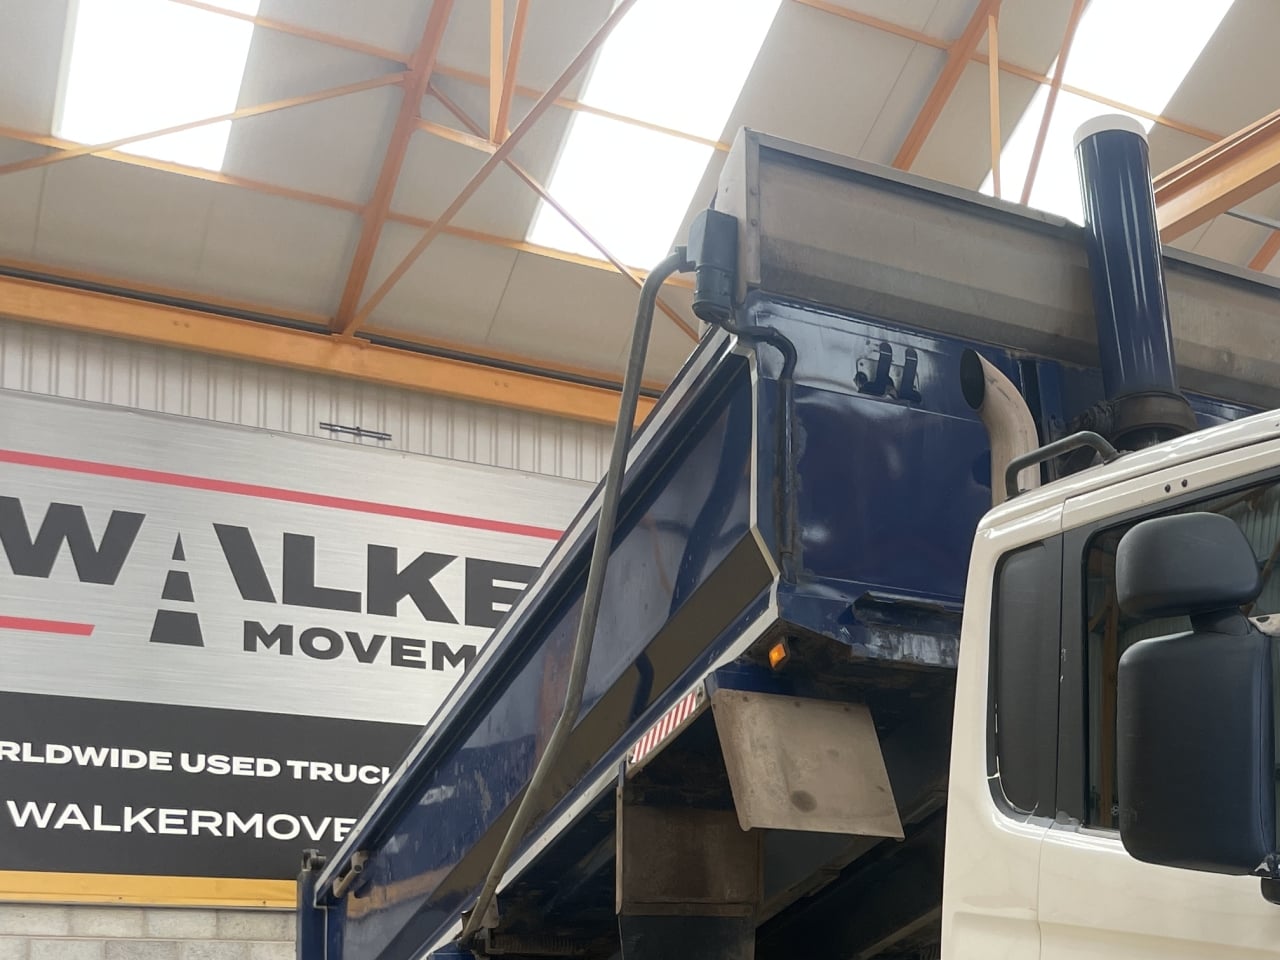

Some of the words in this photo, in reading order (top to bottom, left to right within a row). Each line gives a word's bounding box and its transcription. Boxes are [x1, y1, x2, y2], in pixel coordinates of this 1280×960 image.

[243, 620, 477, 673] MOVEM
[0, 740, 173, 773] RLDWIDE
[180, 753, 282, 778] USED
[8, 800, 358, 842] WALKERMOVE
